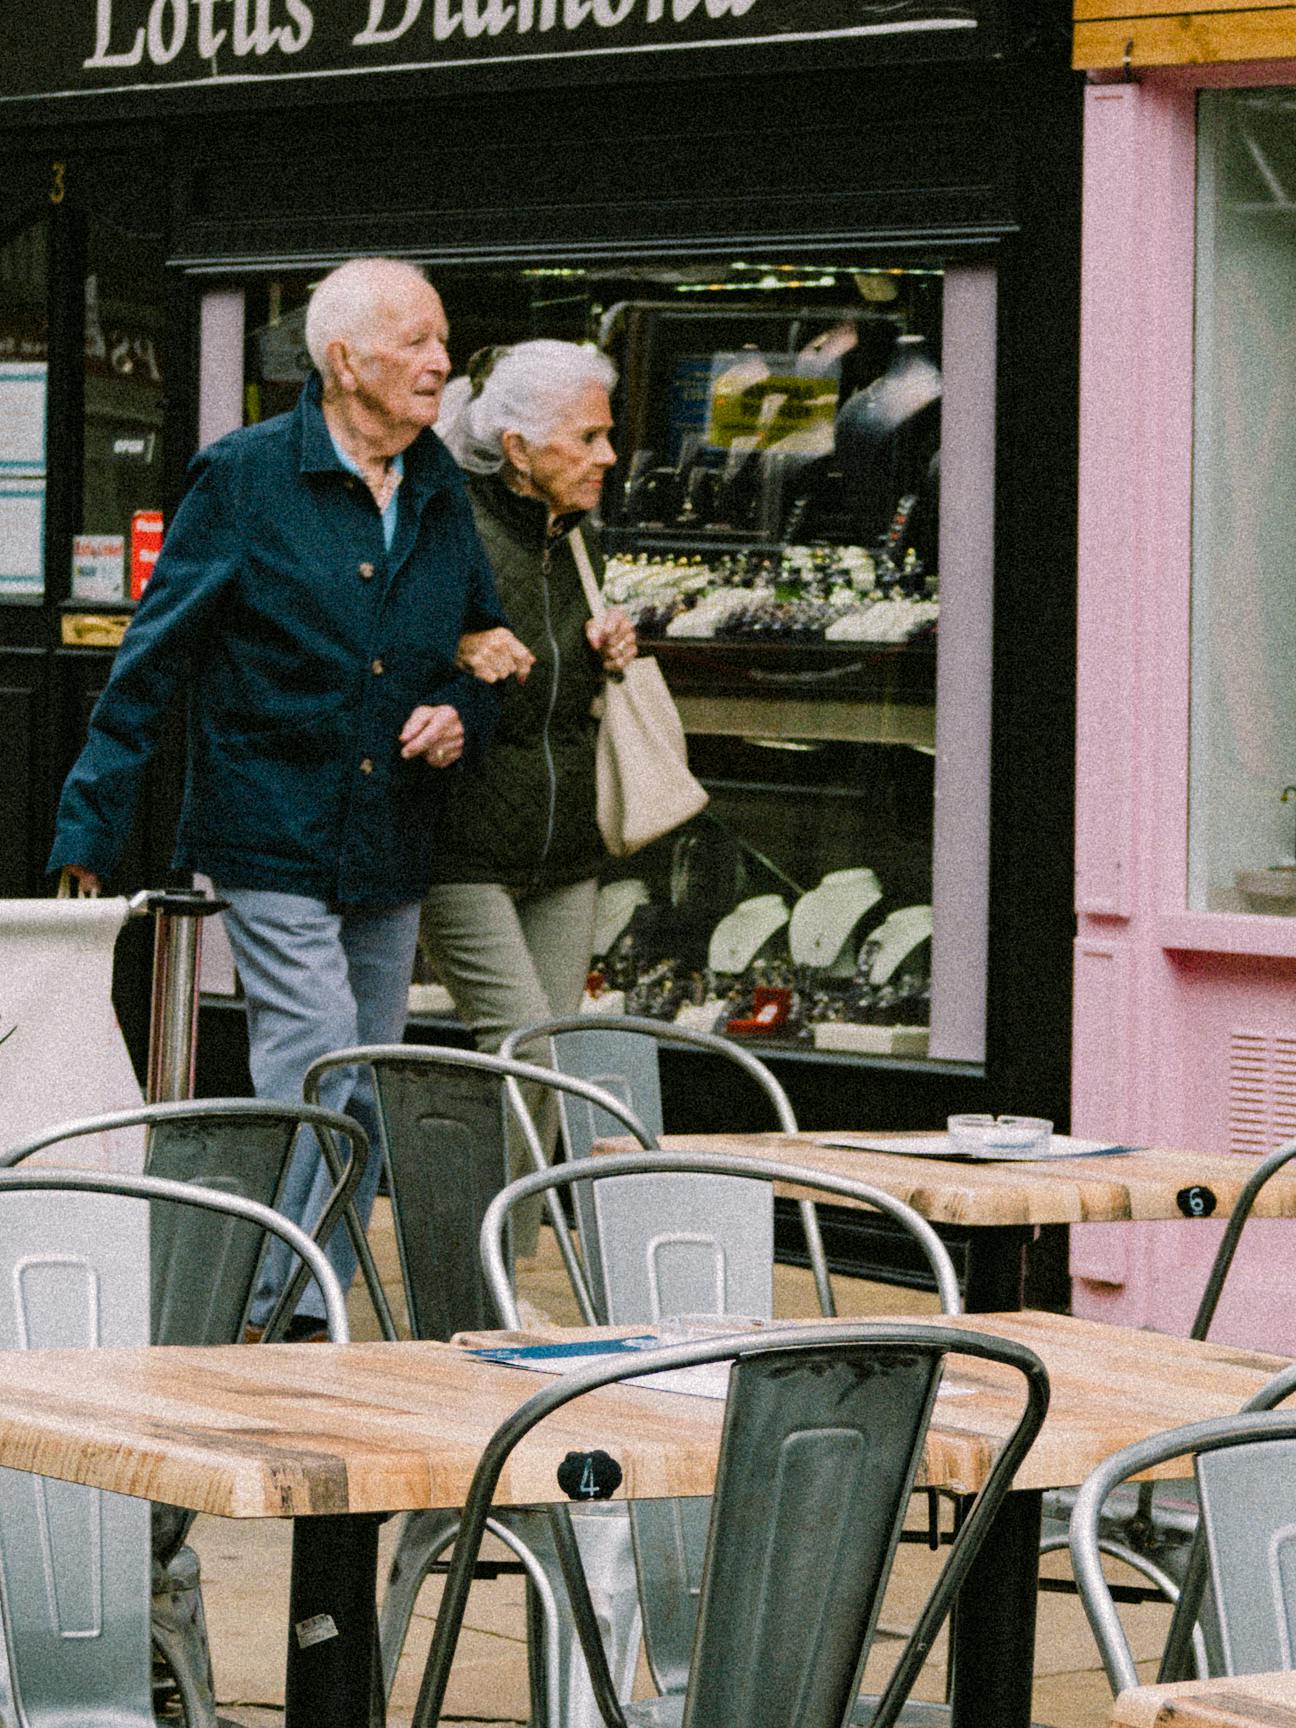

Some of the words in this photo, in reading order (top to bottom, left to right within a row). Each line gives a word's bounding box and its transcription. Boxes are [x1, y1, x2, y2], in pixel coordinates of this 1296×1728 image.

[50, 160, 65, 204] 3
[1189, 1187, 1205, 1211] 6
[579, 1457, 601, 1497] 4
